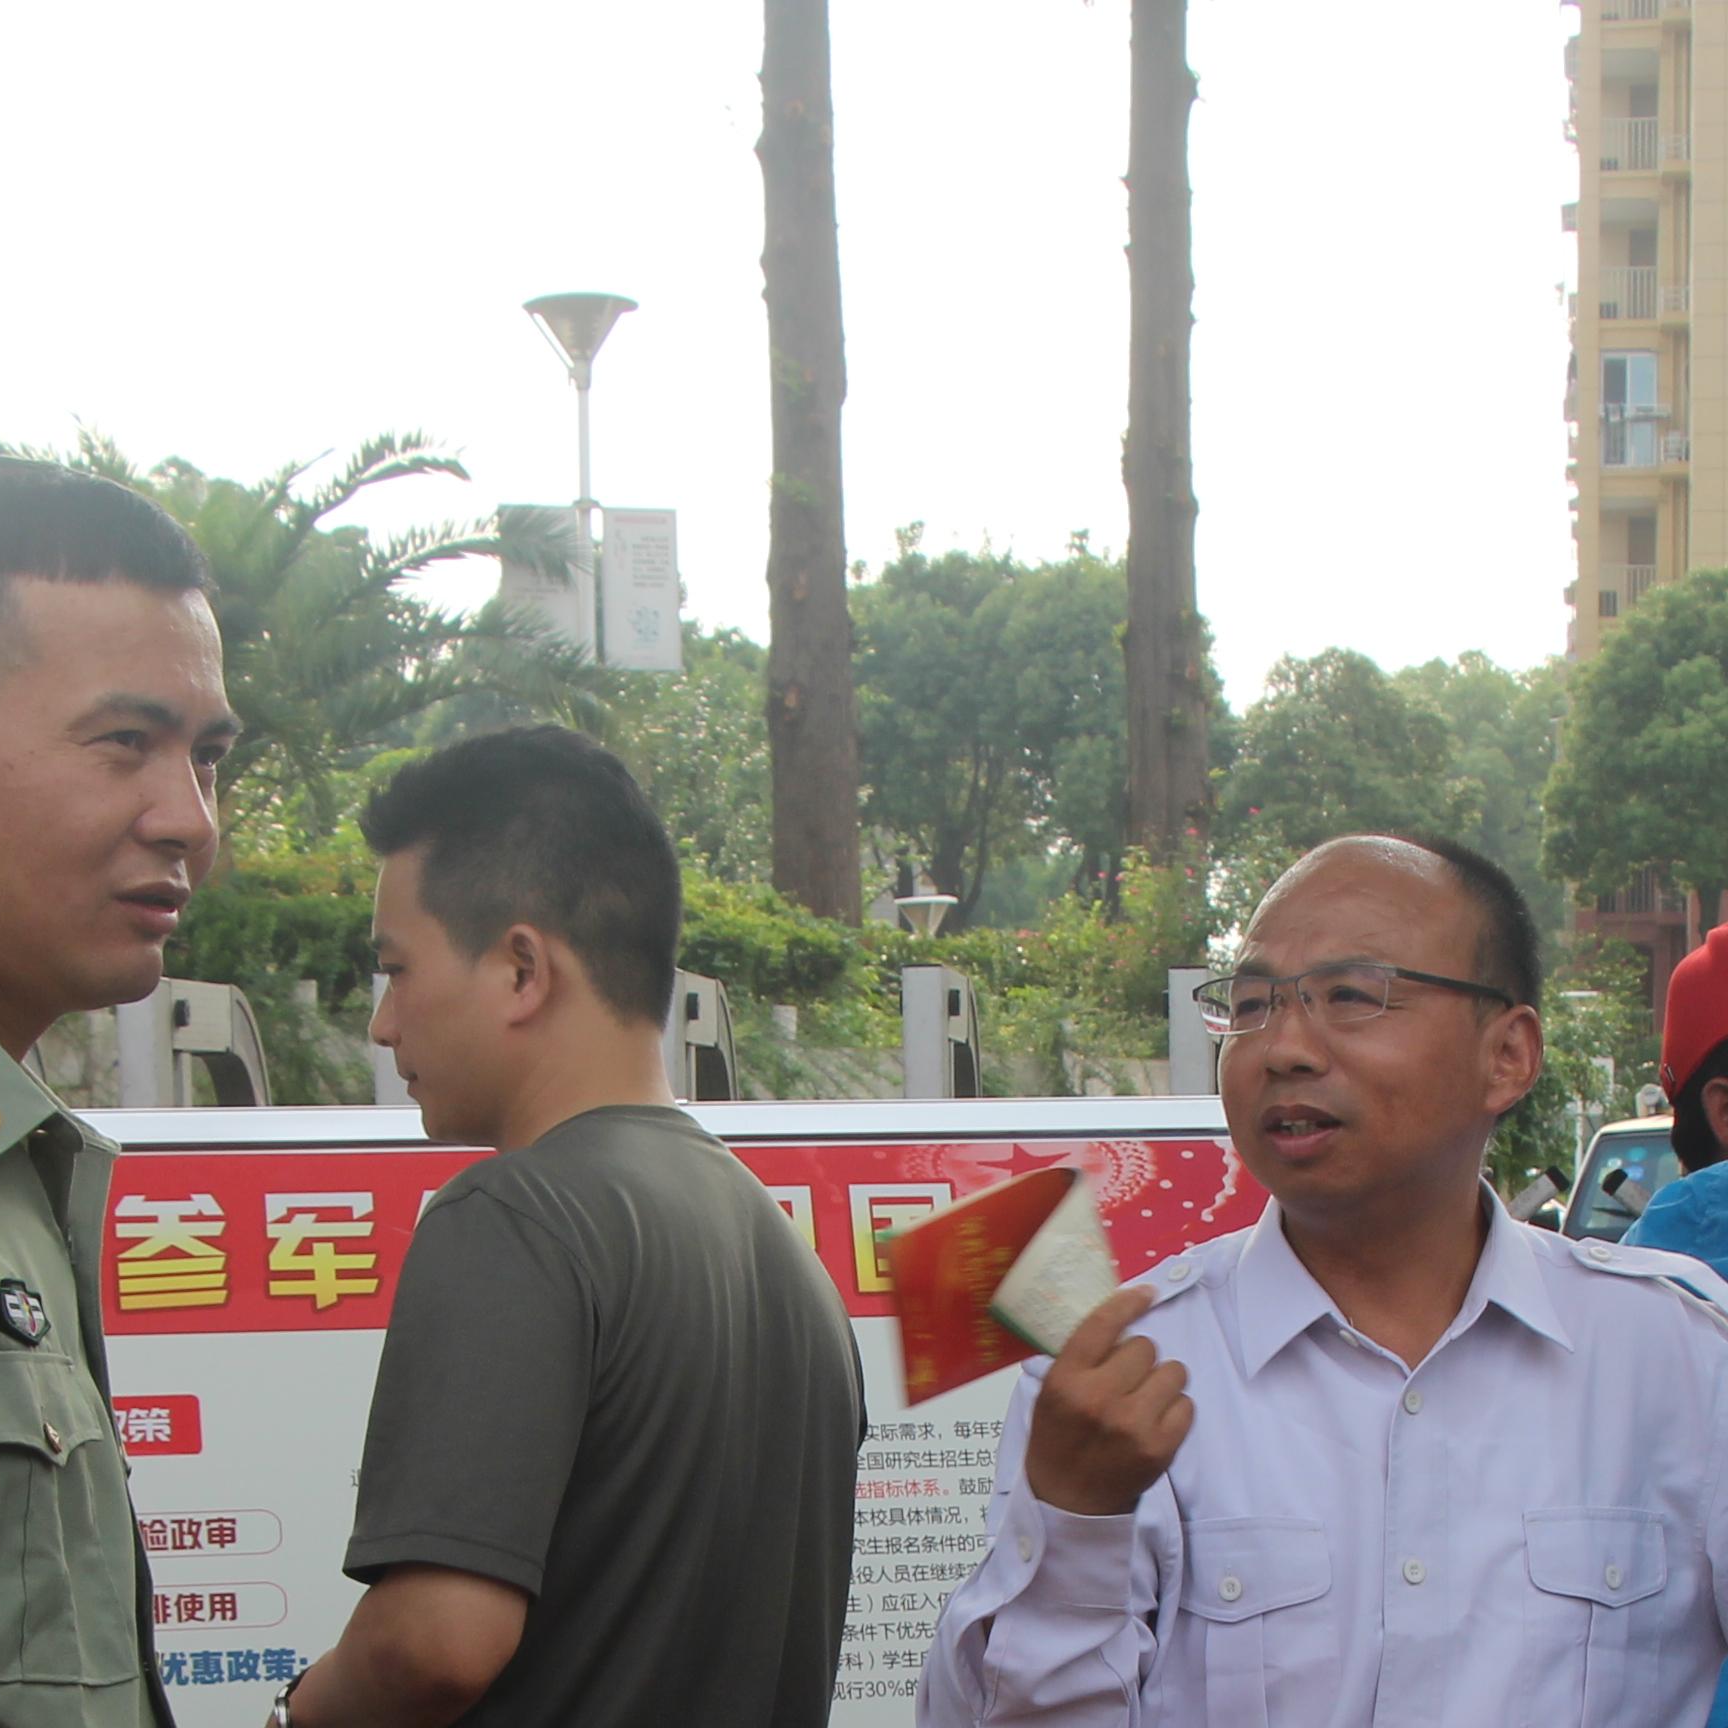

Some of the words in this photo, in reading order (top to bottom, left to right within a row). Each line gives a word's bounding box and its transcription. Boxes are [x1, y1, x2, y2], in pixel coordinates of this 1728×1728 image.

[114, 1190, 438, 1311] 参军
[856, 1449, 997, 1471] 全国研究生招生总
[841, 1619, 936, 1642] 条件下优先
